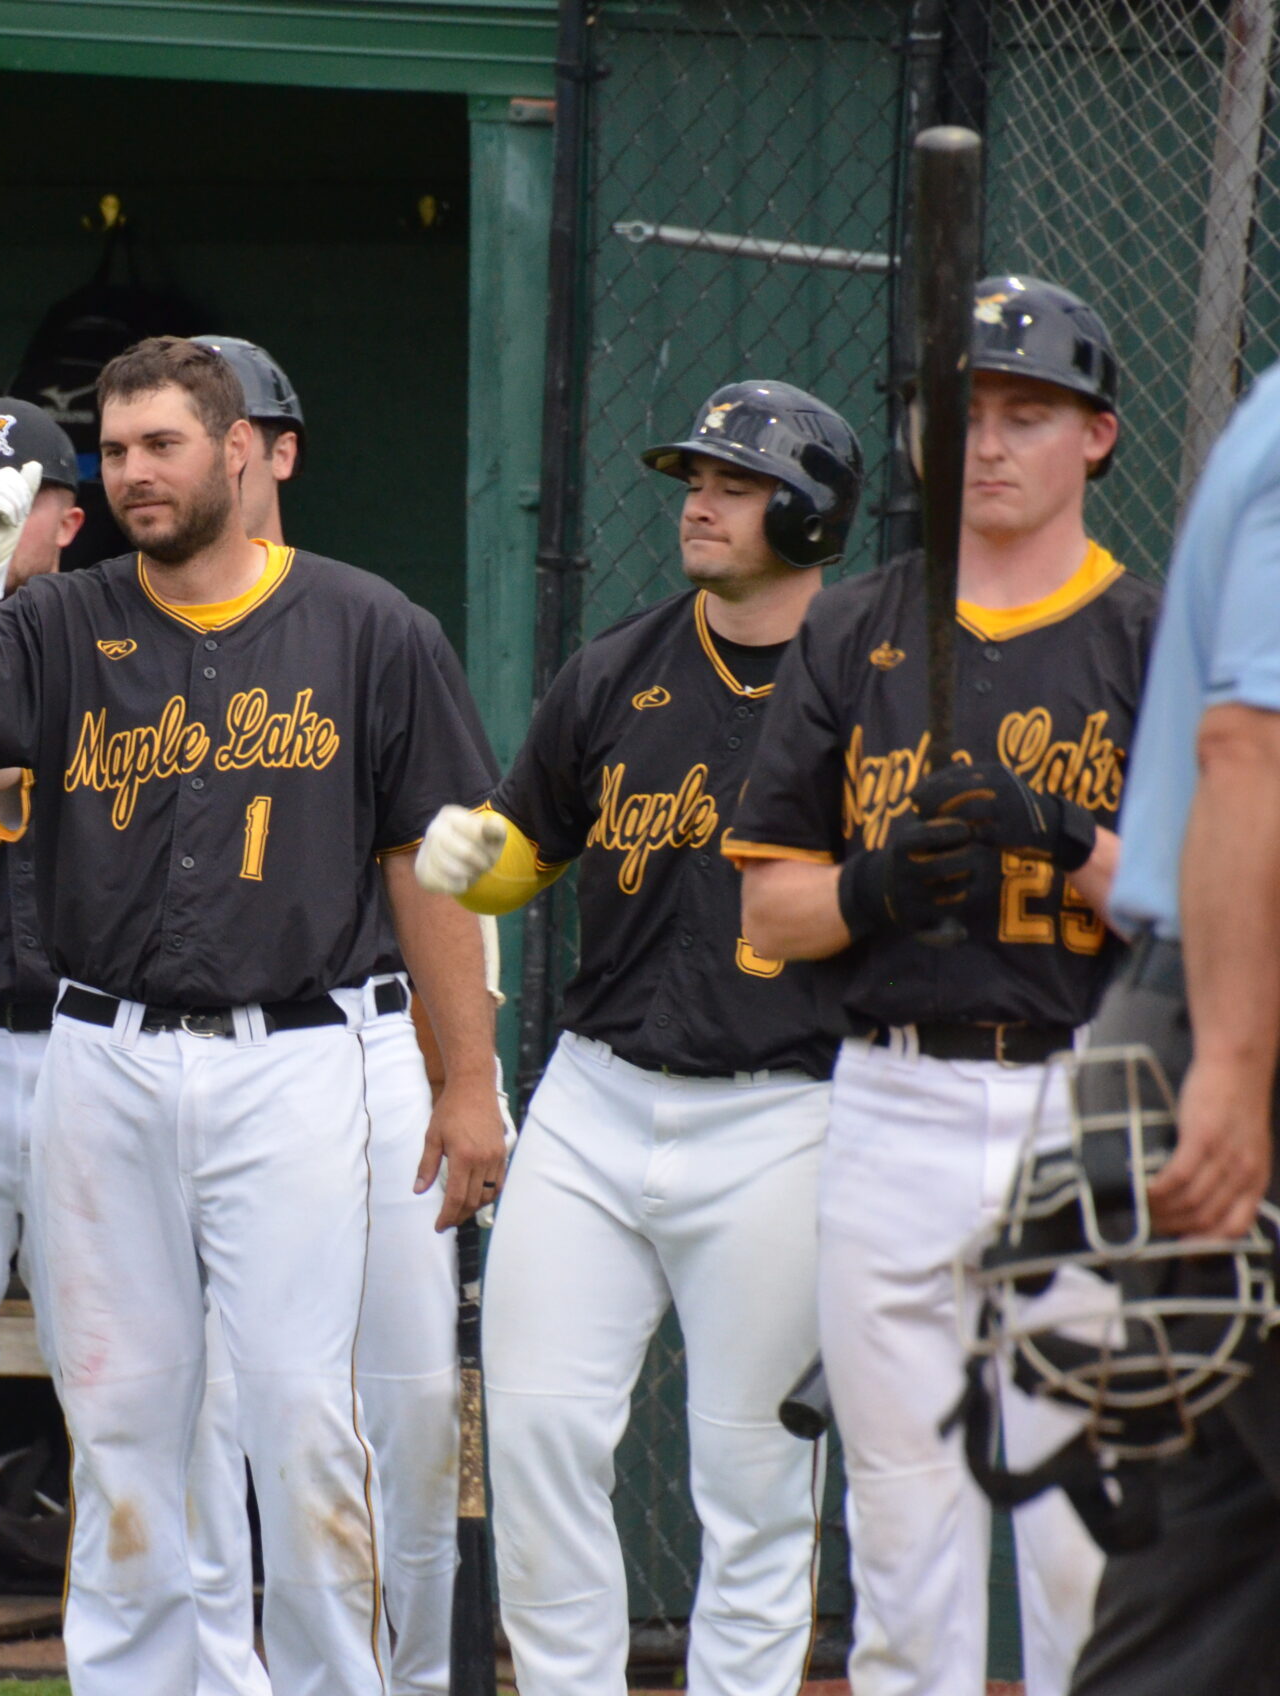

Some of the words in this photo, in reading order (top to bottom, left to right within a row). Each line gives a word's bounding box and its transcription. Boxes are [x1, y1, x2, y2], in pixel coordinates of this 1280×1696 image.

[65, 696, 209, 830] Maple
[215, 687, 339, 770] Lake
[239, 796, 272, 881] 1
[586, 762, 719, 895] Maple
